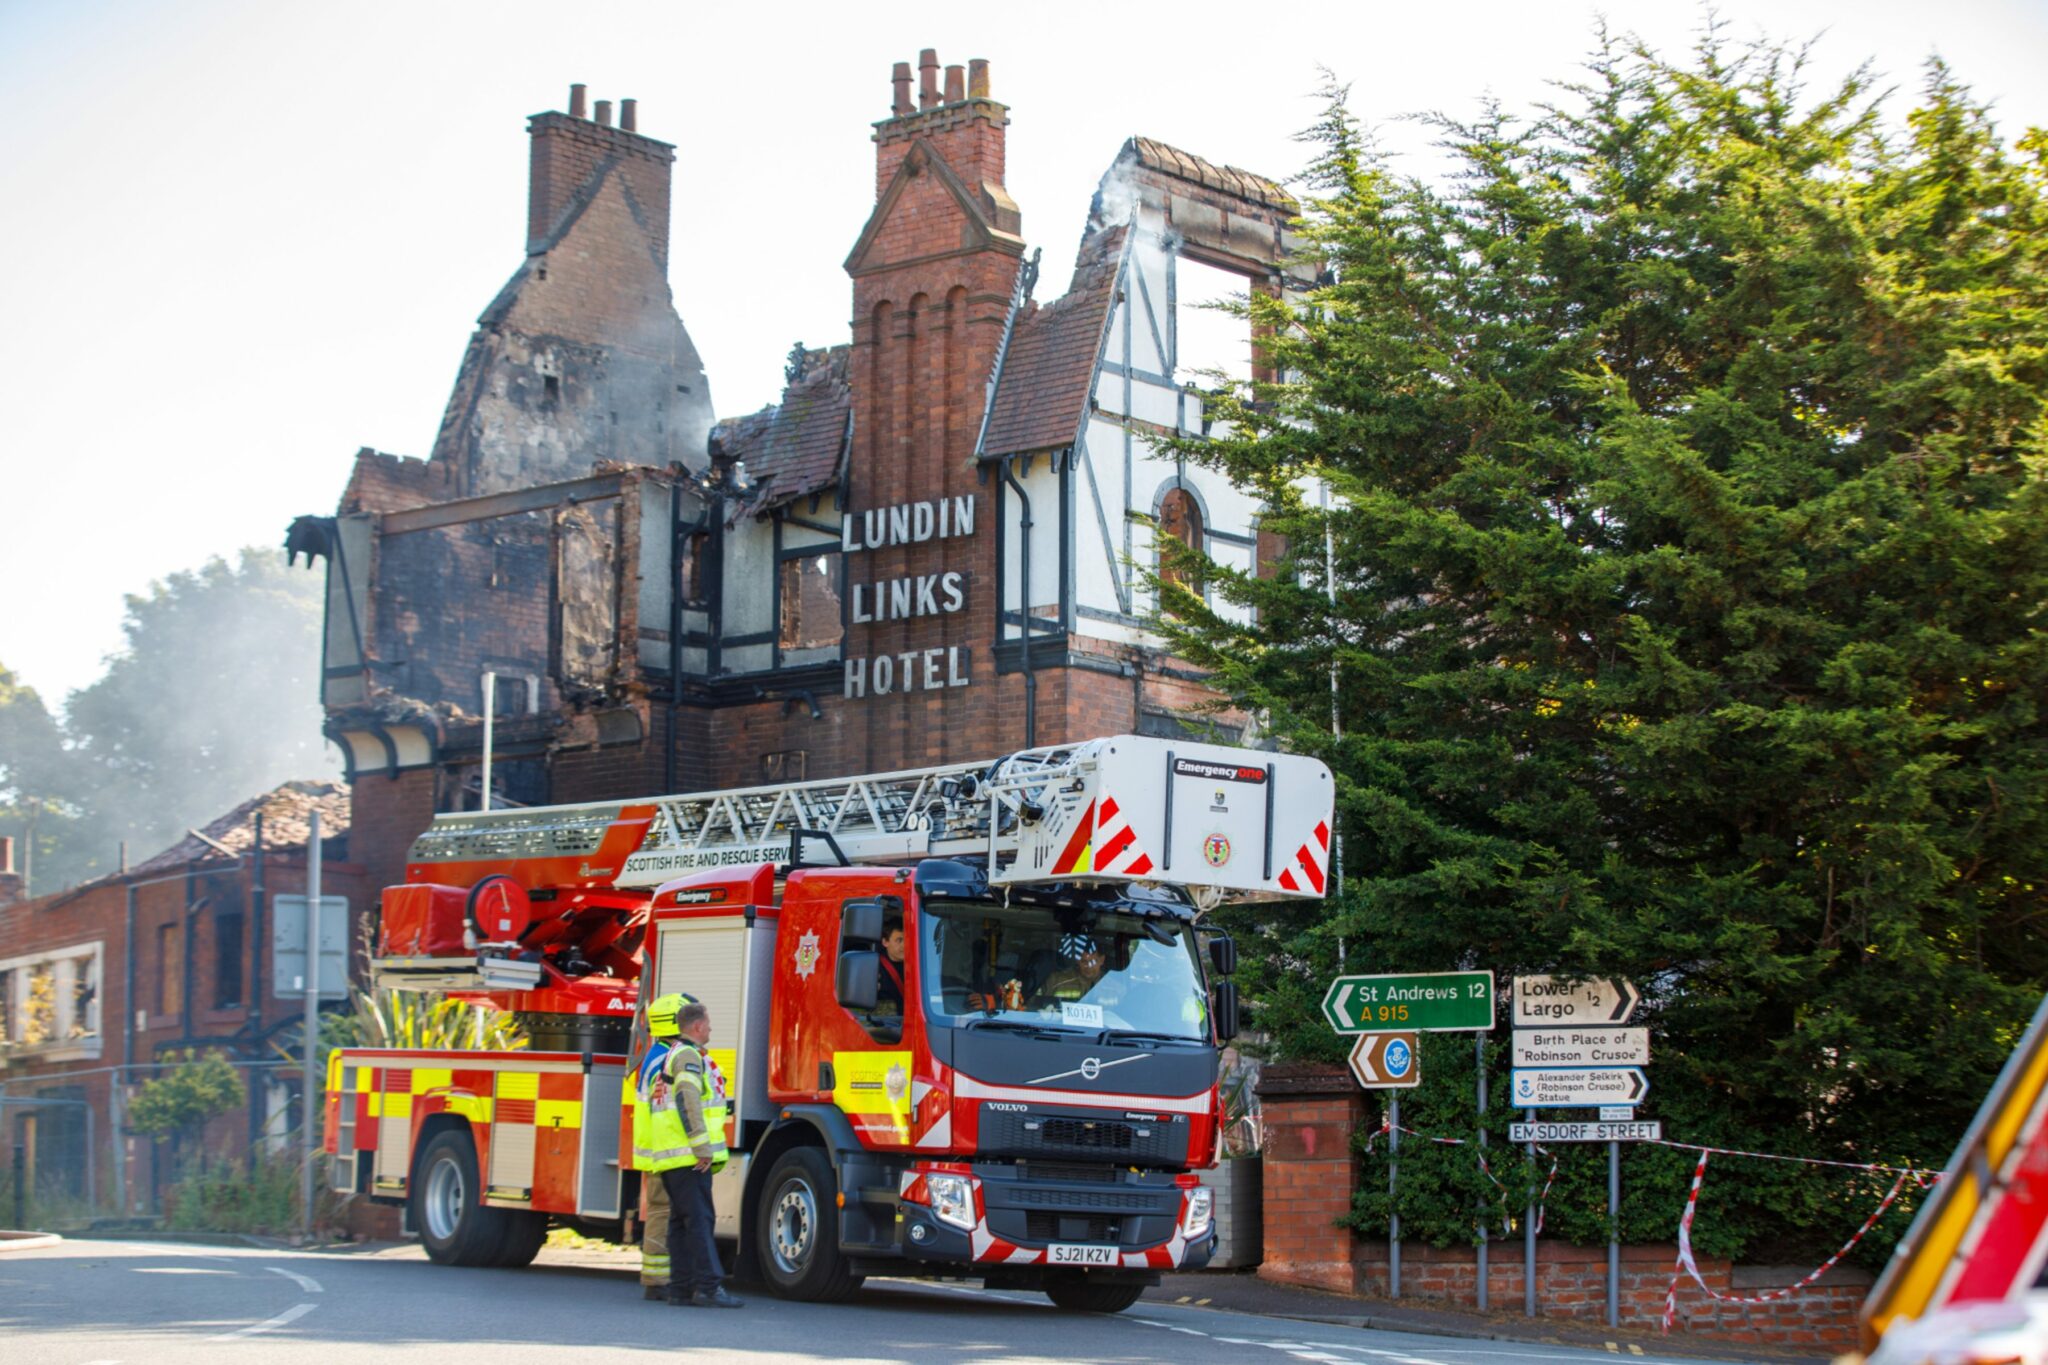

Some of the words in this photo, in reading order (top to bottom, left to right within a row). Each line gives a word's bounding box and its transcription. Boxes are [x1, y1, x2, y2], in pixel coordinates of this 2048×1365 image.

[842, 494, 975, 552] LUNDIN
[852, 571, 963, 624] LINKS
[844, 646, 969, 698] HOTEL
[627, 856, 672, 872] SCOTTISH
[674, 854, 694, 869] FIRE
[697, 853, 719, 867] AND
[721, 849, 760, 865] RESCUE
[763, 845, 805, 862] SERVIE
[1360, 986, 1378, 1002] St
[1386, 985, 1457, 1001] Andrews
[1468, 983, 1485, 998] 12
[1522, 981, 1577, 996] Lower
[1361, 1006, 1372, 1021] A
[1379, 1005, 1408, 1021] 915
[1523, 1002, 1574, 1018] Largo
[1534, 1035, 1565, 1045] Birth
[1571, 1034, 1606, 1045] Place
[1614, 1033, 1627, 1044] of
[1537, 1073, 1585, 1081] Alexander
[1589, 1072, 1623, 1081] Selkirk
[1536, 1083, 1584, 1092] (Robinson
[1588, 1082, 1626, 1092] Crusoe)
[1538, 1094, 1570, 1102] Statue
[987, 1102, 1028, 1112] VOLVO
[1513, 1124, 1588, 1139] EMSDORF
[1597, 1123, 1655, 1138] STREET
[1055, 1247, 1084, 1262] SJ21
[1087, 1248, 1112, 1263] KZV
